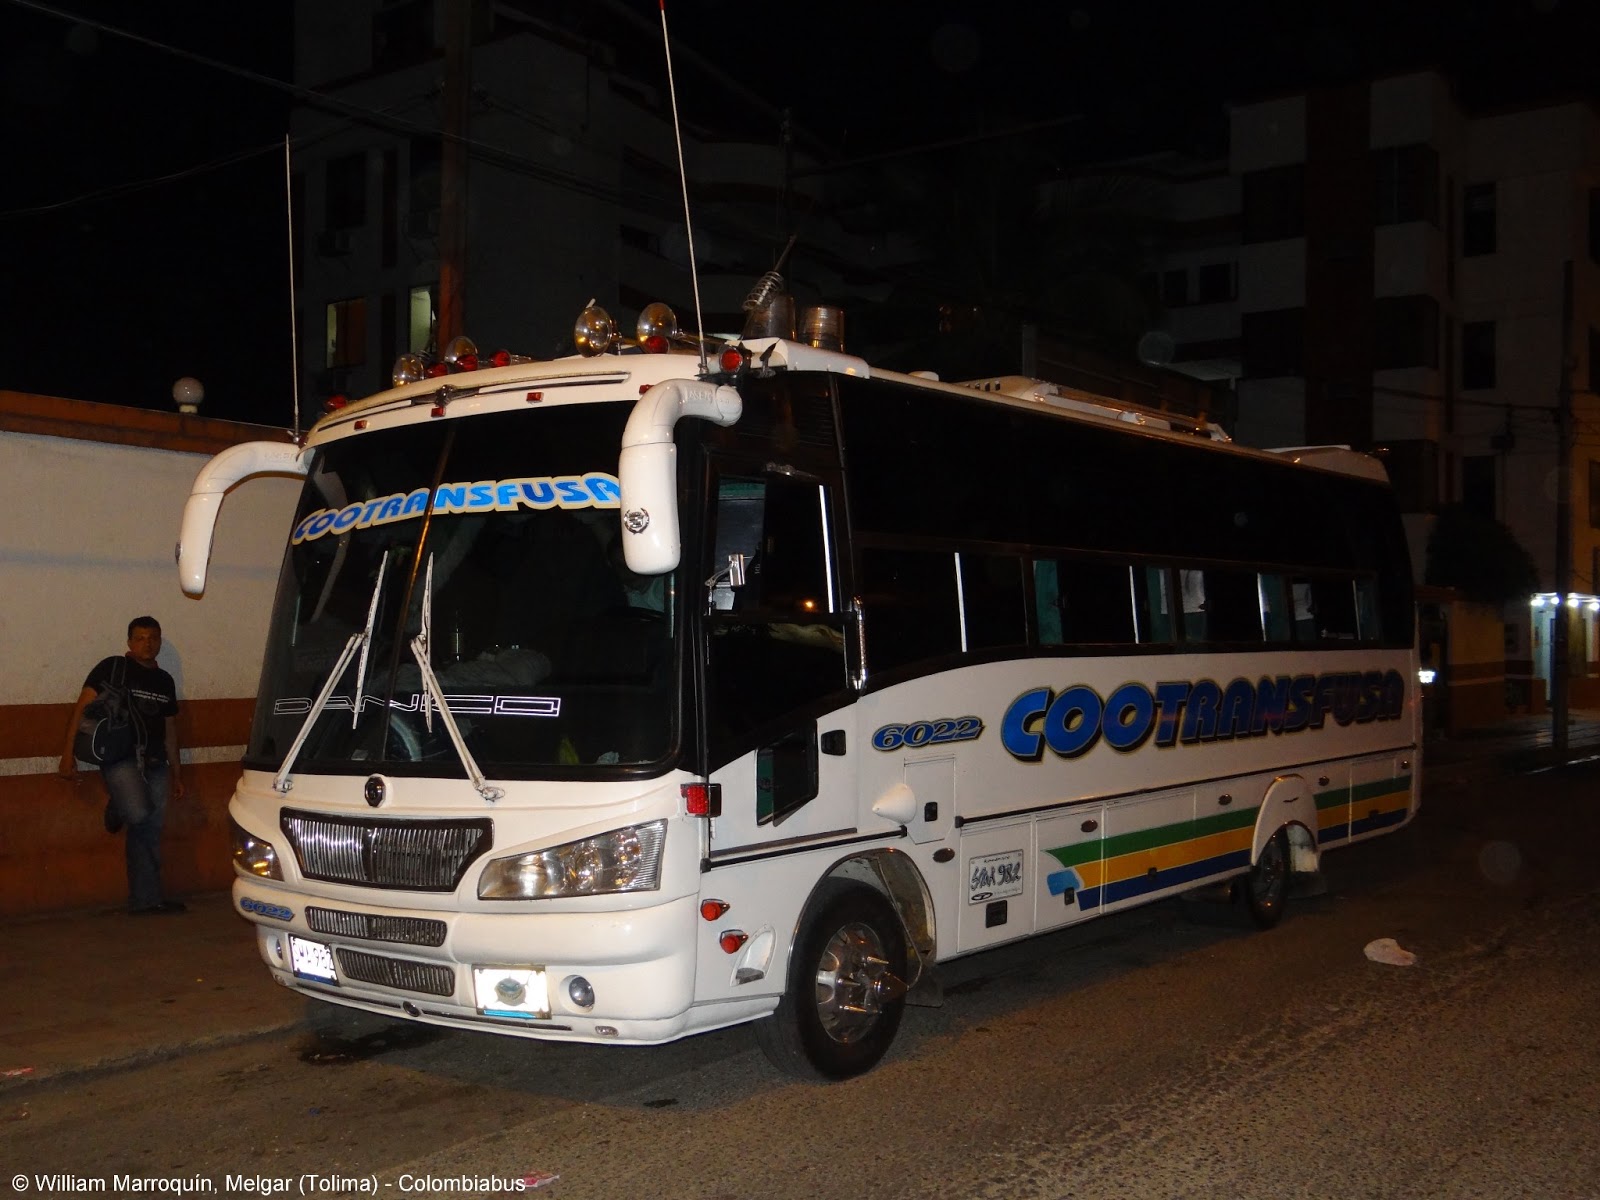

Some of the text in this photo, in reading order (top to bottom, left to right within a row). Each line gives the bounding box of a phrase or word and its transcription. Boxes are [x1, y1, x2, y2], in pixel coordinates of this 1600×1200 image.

[292, 472, 621, 545] COOTRANSFUSA
[872, 716, 985, 751] 6022
[1001, 669, 1405, 762] COOTRANSFUSA
